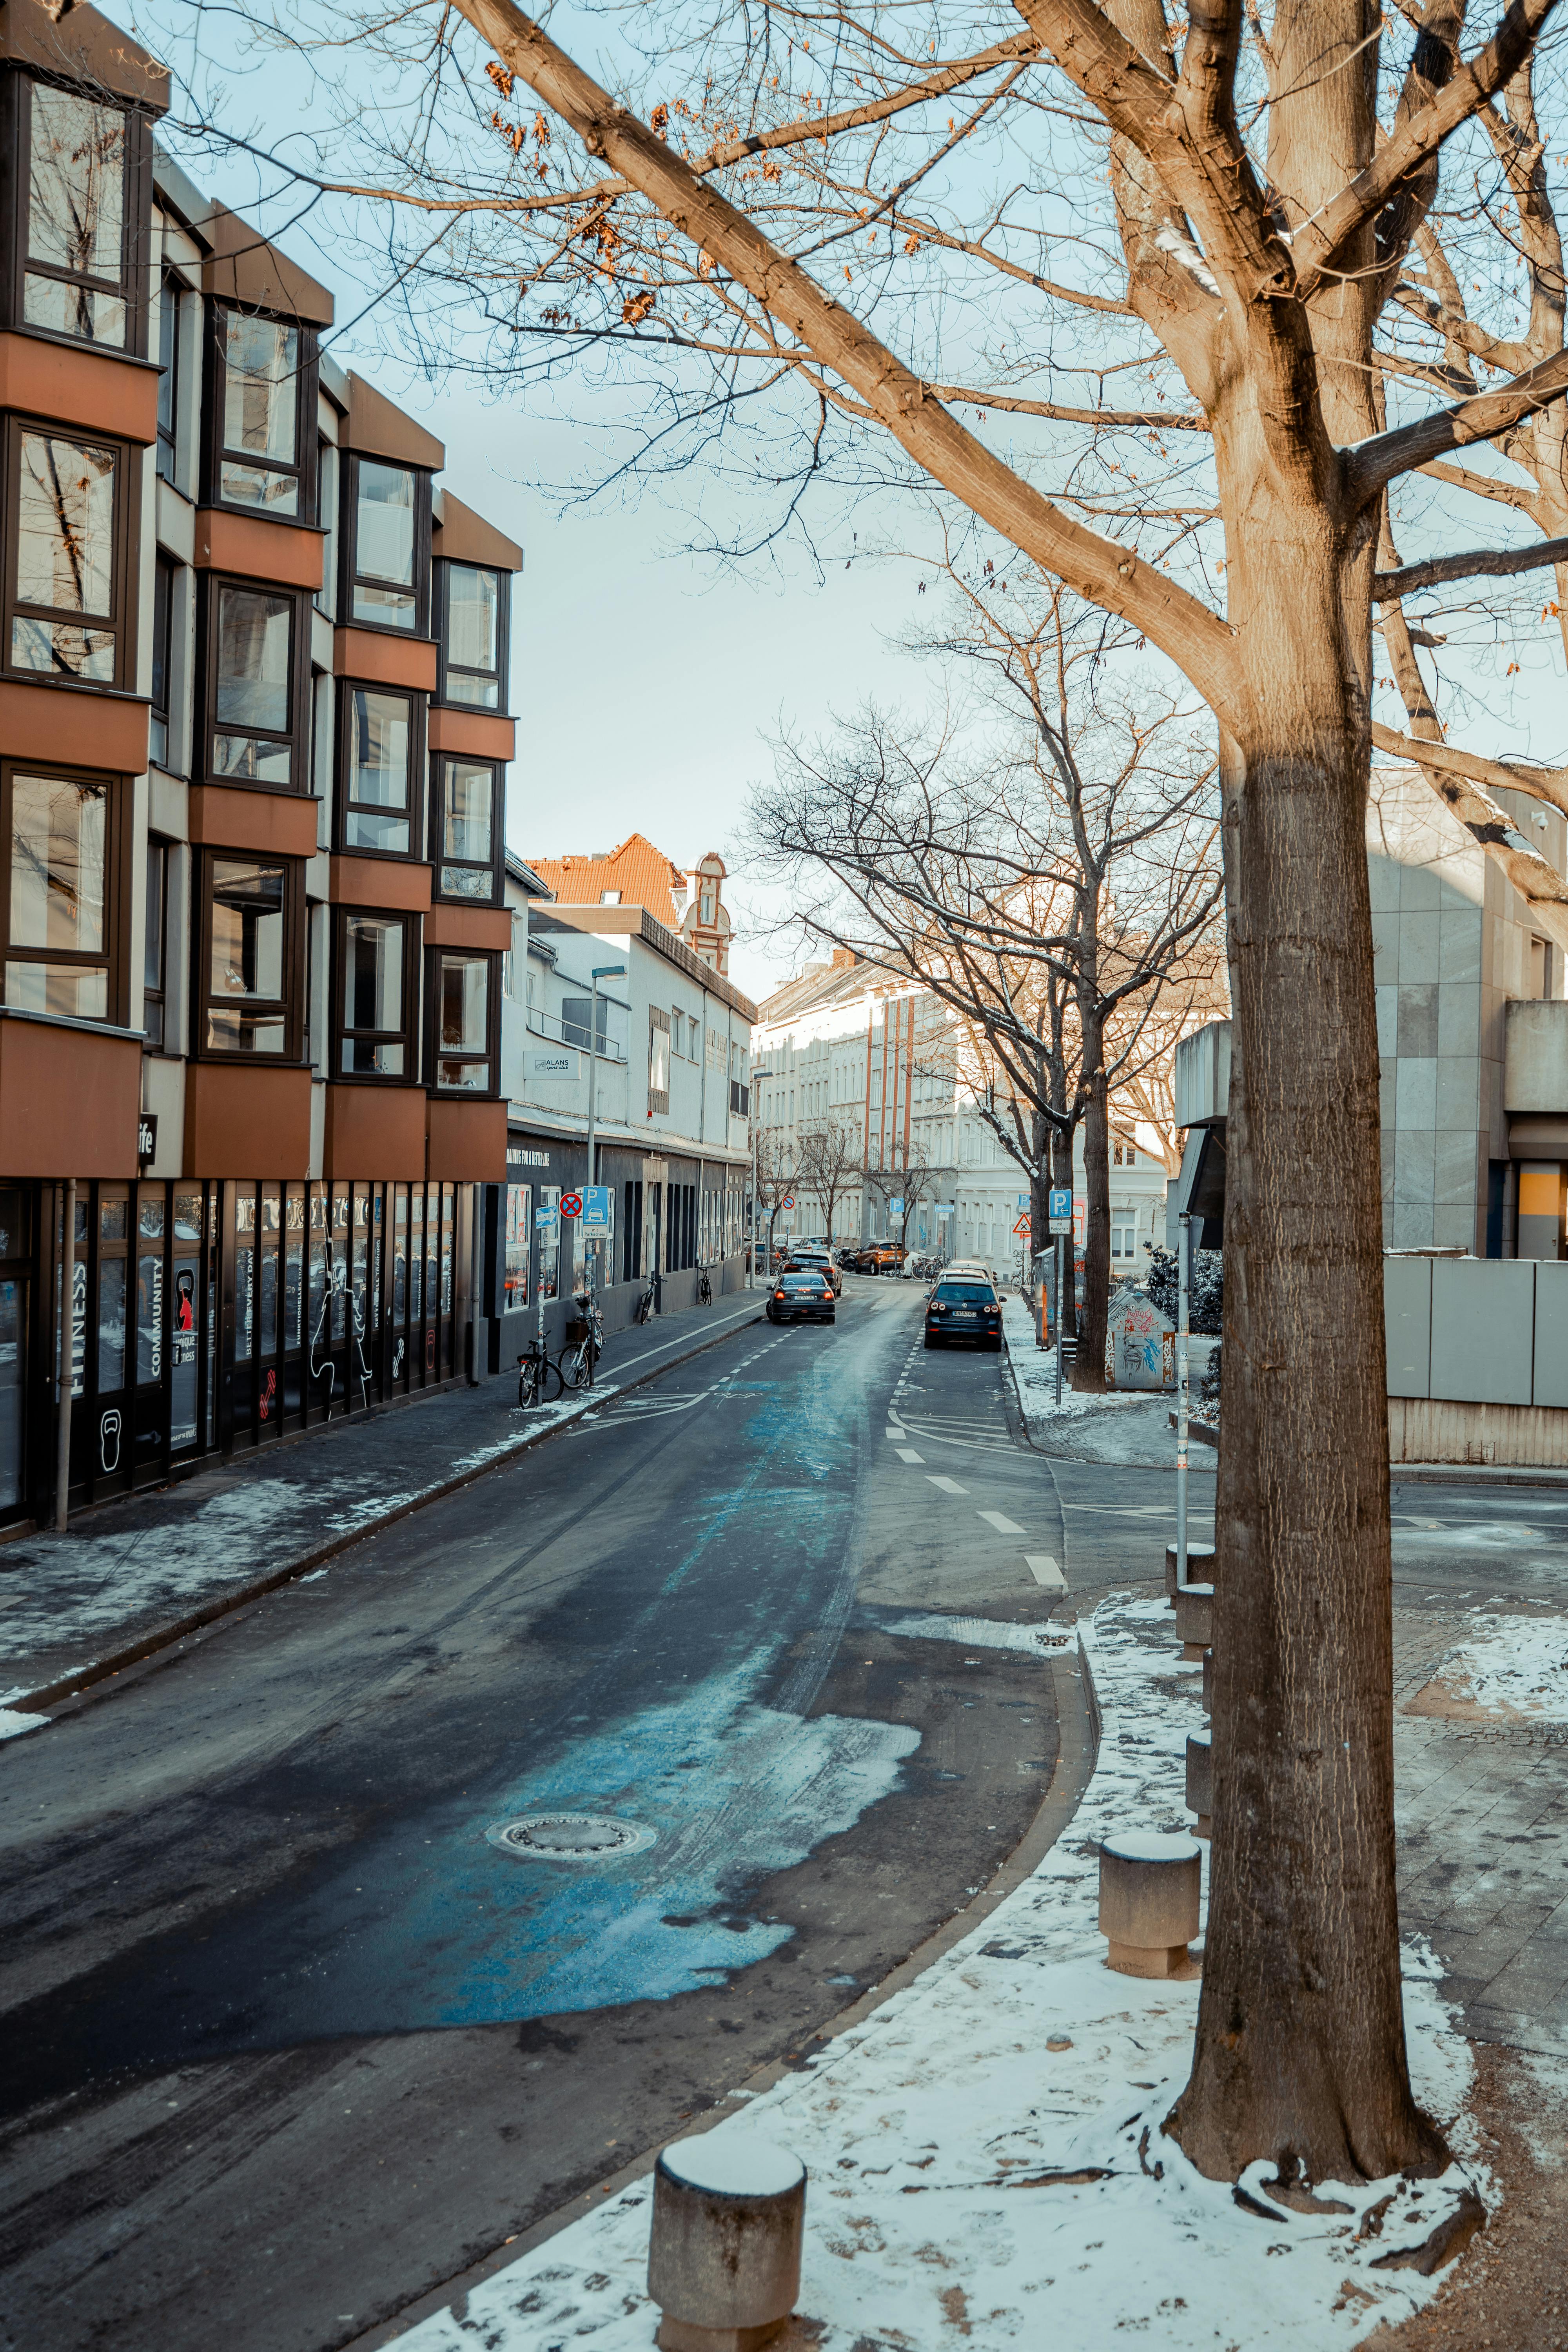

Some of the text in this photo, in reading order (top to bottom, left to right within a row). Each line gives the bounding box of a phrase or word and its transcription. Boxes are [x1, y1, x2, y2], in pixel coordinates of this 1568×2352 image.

[529, 1151, 532, 1165] A
[532, 1151, 543, 1166] BETTER
[586, 1189, 598, 1204] P
[1021, 1196, 1028, 1205] P
[1054, 1194, 1066, 1214] P
[893, 1200, 901, 1210] P
[152, 1259, 162, 1377] COMMUNITY
[176, 1334, 195, 1350] unique
[176, 1350, 194, 1364] fness
